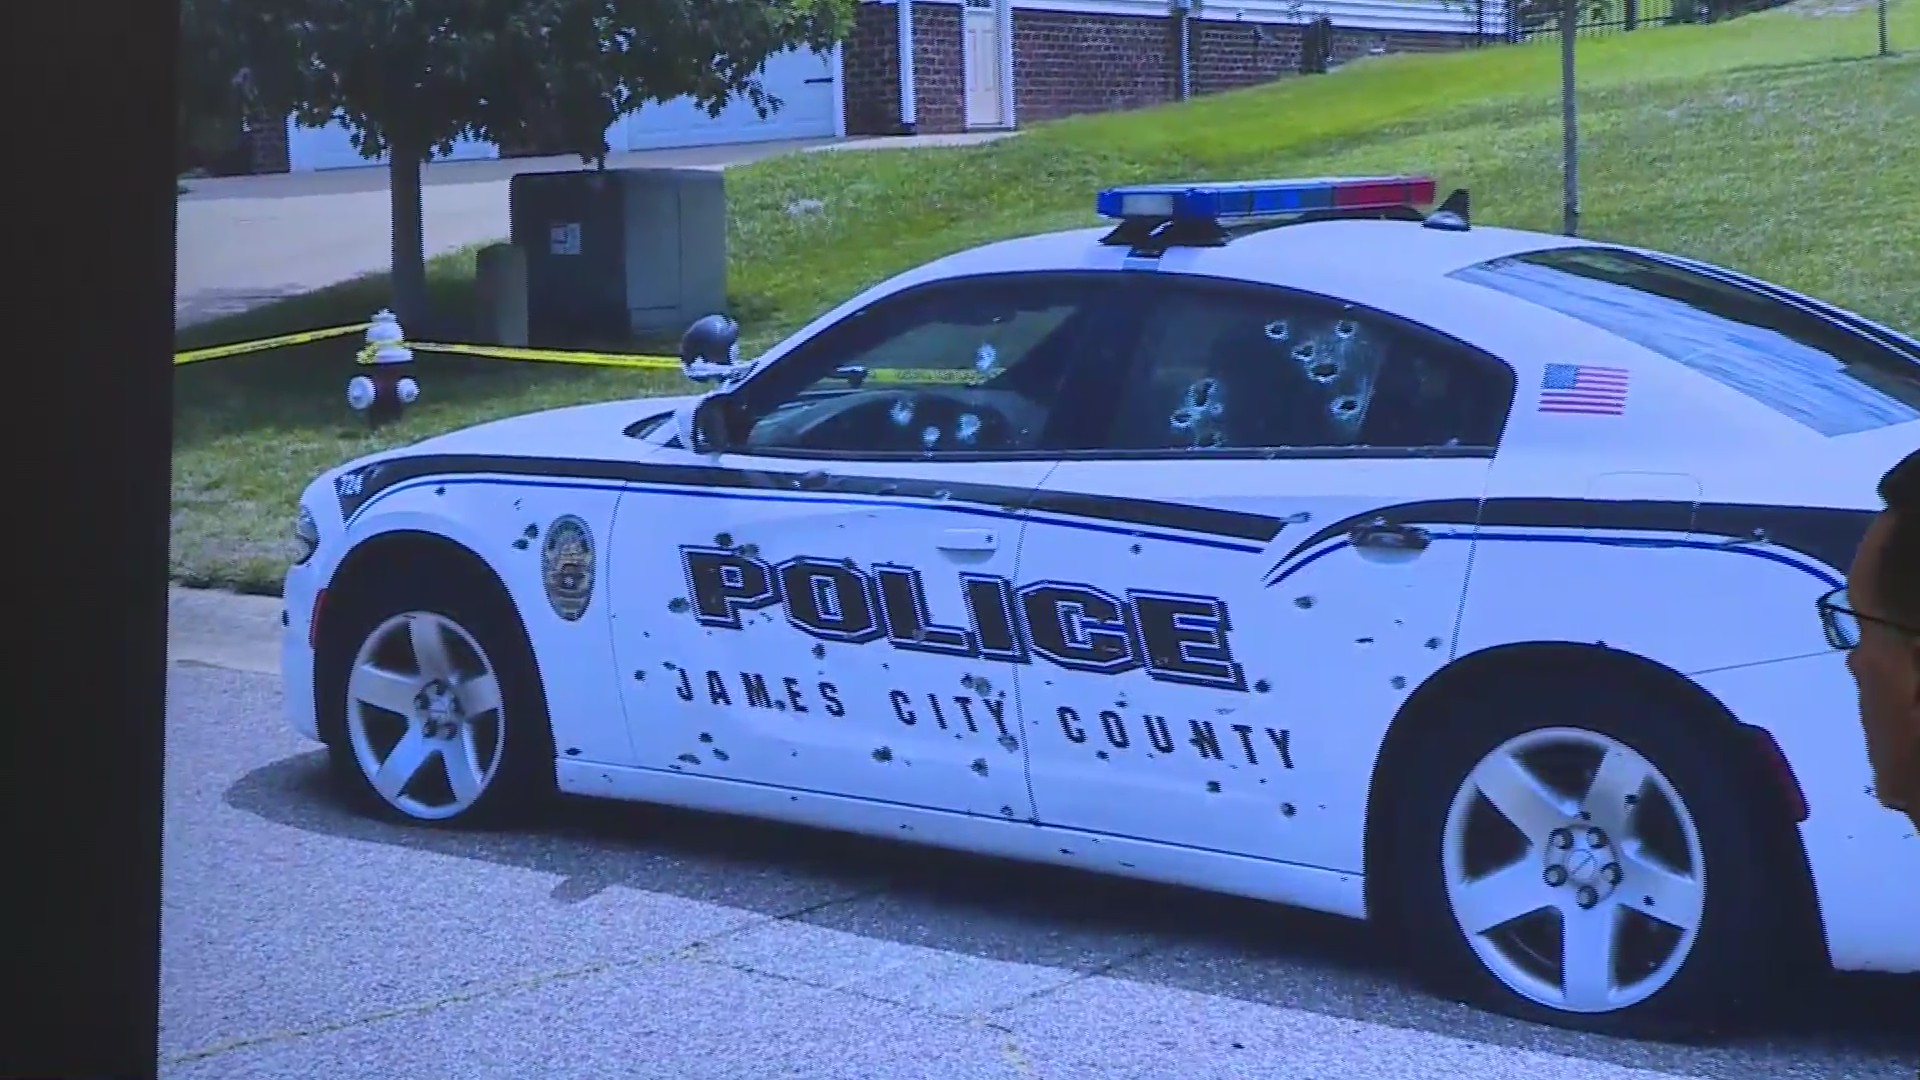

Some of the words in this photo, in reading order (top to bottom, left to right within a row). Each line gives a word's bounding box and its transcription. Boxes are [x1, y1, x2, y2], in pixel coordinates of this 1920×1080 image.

[679, 545, 1248, 692] POLICE
[676, 668, 845, 717] JAMES
[889, 690, 1009, 735] CITY
[1057, 706, 1294, 769] COUNTY
